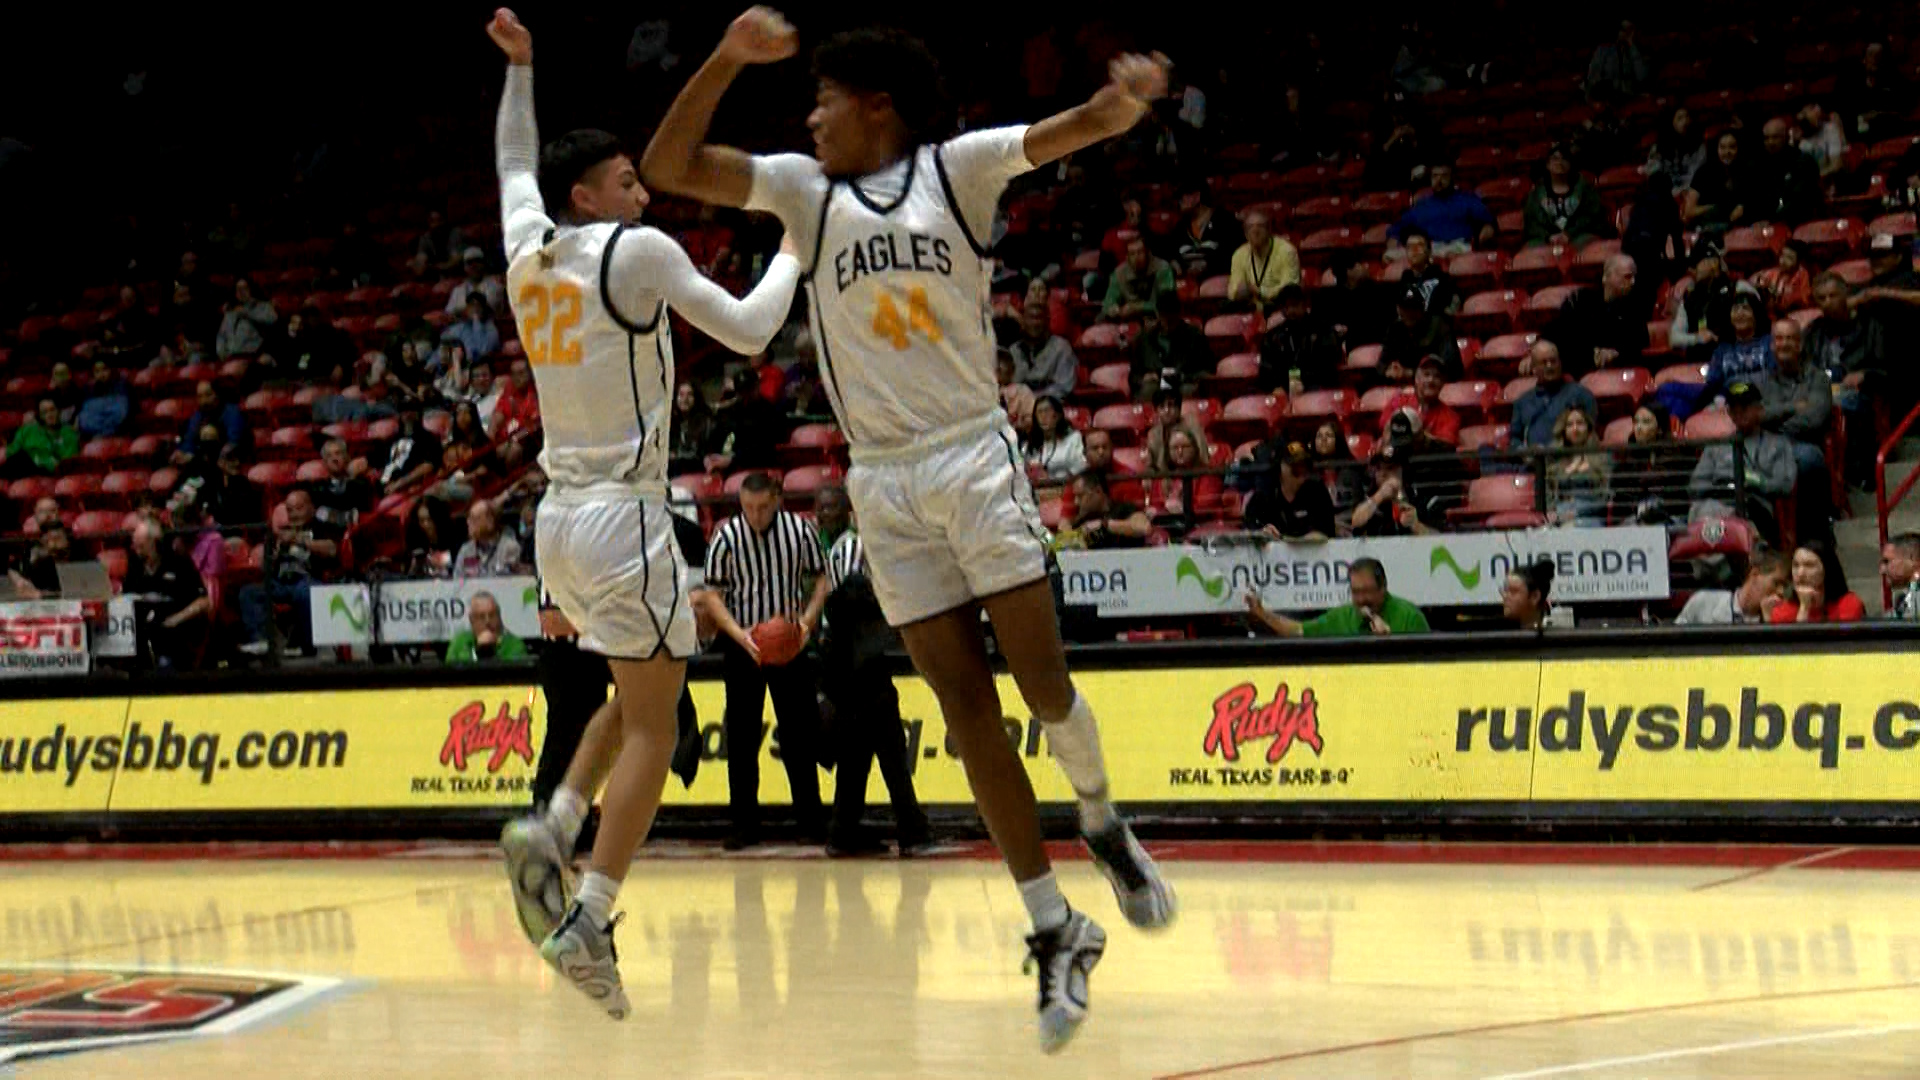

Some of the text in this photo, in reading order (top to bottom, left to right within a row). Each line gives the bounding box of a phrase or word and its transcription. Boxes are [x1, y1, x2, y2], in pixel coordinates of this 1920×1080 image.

[836, 232, 952, 293] EAGLES
[519, 281, 583, 366] 22
[873, 287, 943, 350] 44
[1068, 569, 1128, 592] NDA
[1232, 560, 1351, 588] NUSEND
[377, 598, 465, 622] NUSEND
[1203, 682, 1324, 764] Rudy's
[0, 721, 348, 787] udysbbq.com
[411, 777, 443, 792] REAL
[450, 777, 491, 791] TEXAS
[1170, 768, 1212, 785] REAL
[1217, 768, 1273, 785] TEXAS
